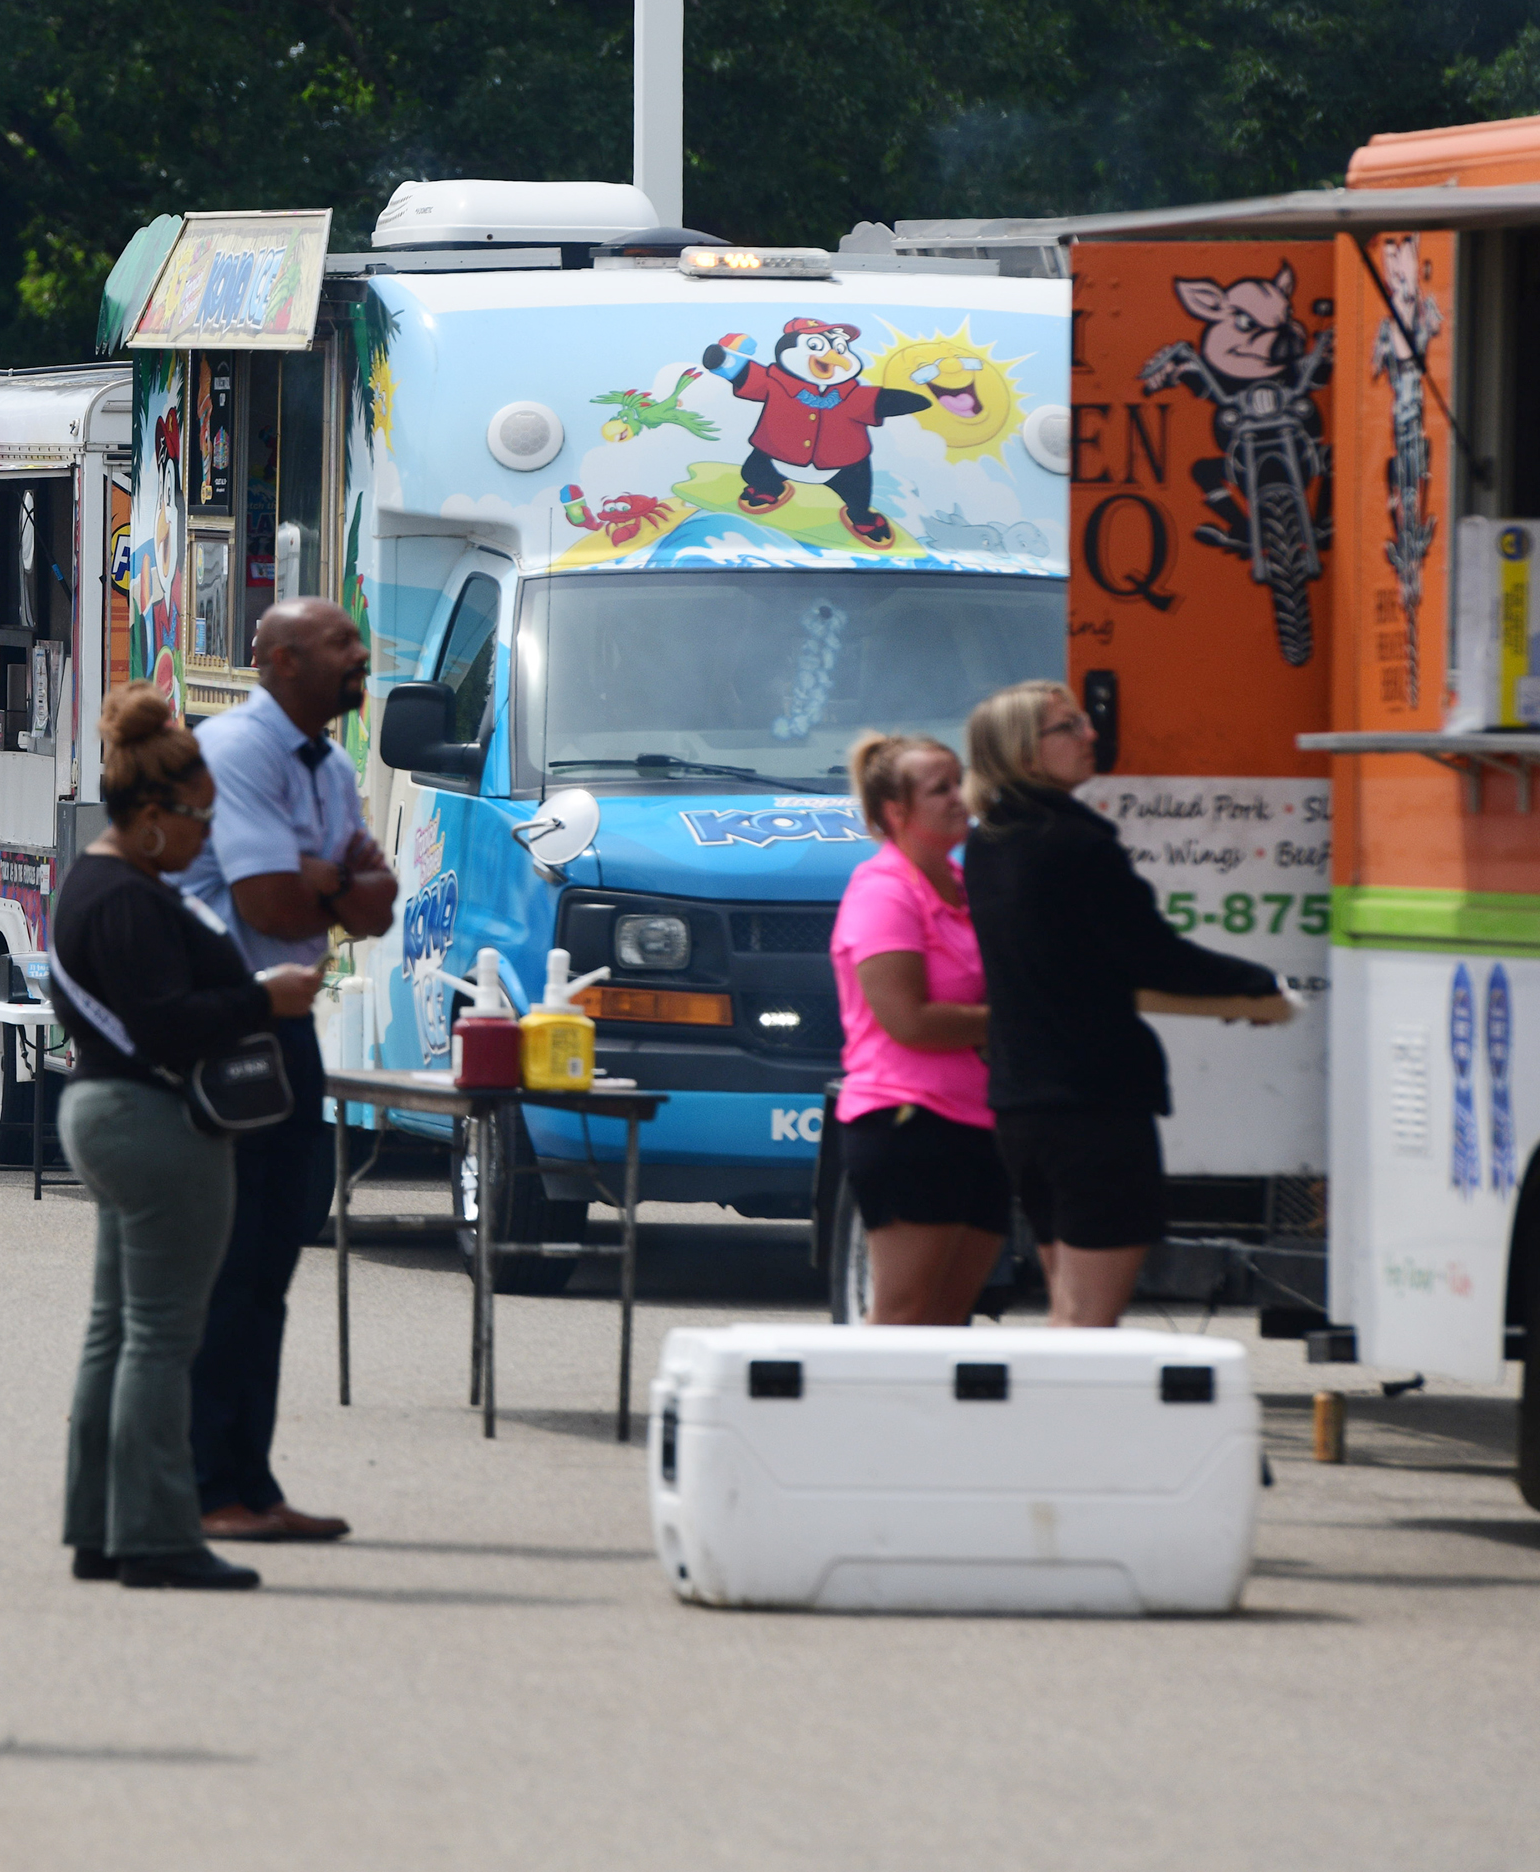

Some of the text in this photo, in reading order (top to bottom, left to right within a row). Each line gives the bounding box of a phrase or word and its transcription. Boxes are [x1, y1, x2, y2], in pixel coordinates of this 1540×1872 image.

[193, 249, 255, 334] KONA
[238, 245, 288, 329] ICE
[1117, 793, 1273, 822] Pulled Pork
[1163, 840, 1247, 875] Wings
[402, 869, 458, 982] KONA
[412, 975, 450, 1065] ICE
